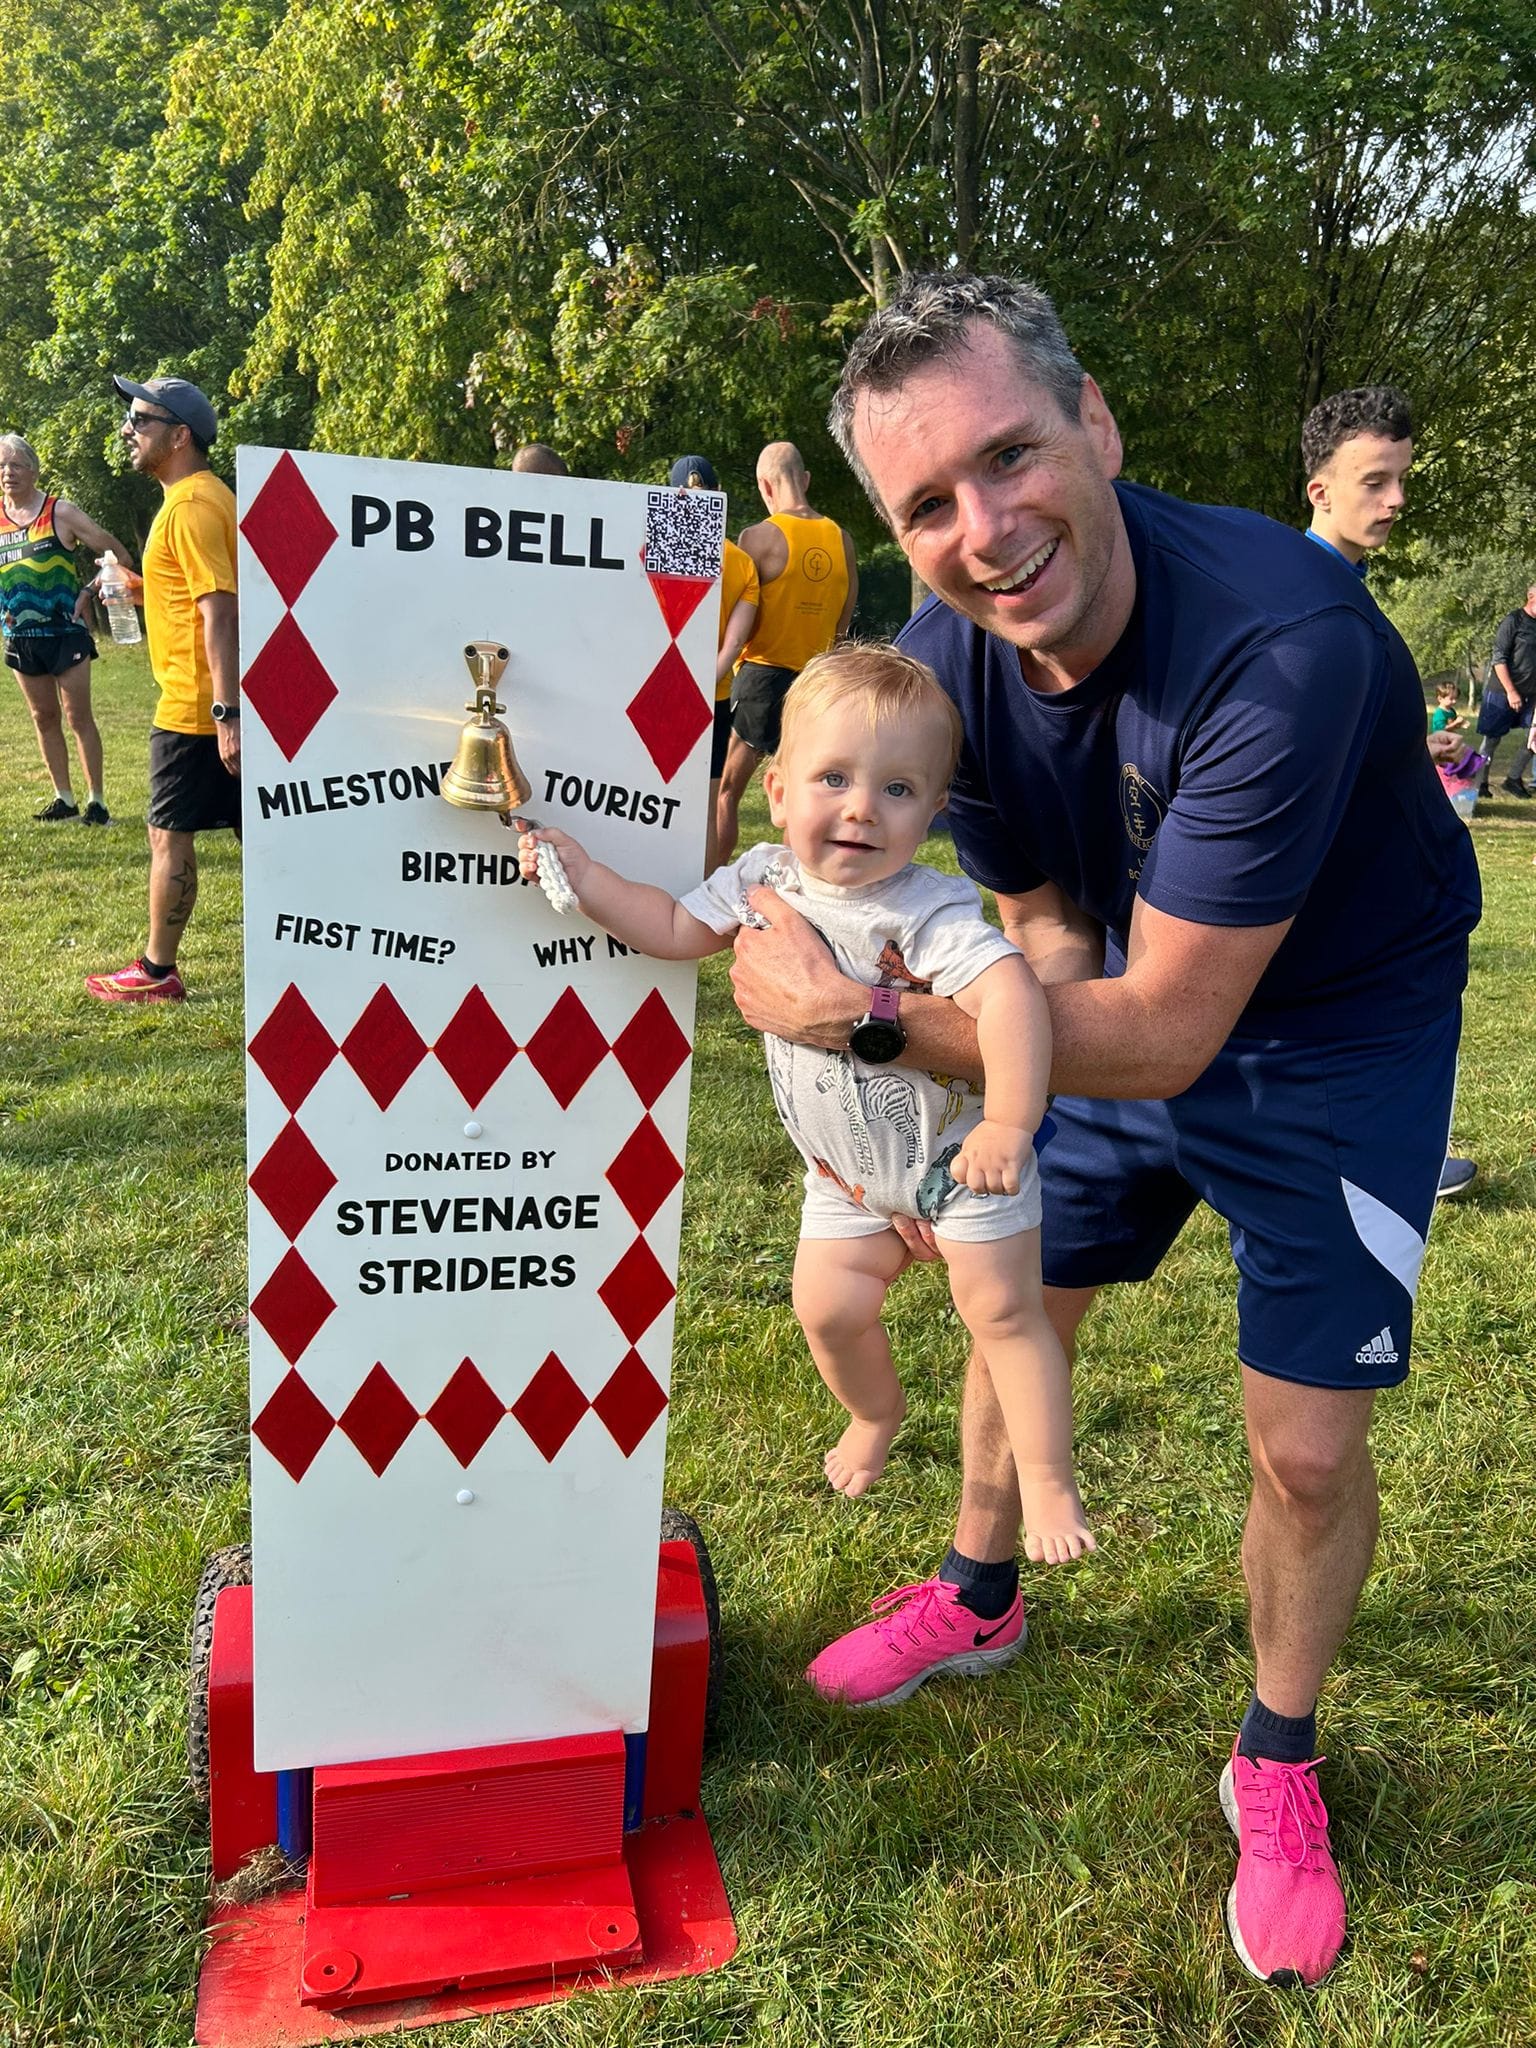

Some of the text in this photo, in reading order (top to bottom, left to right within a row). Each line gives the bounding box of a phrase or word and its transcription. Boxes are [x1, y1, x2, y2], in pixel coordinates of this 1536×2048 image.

[351, 494, 625, 571] PB BELL
[544, 769, 681, 830] TOURIST
[402, 850, 530, 887] BIRTHD
[275, 913, 456, 964] FIRST TIME?
[532, 933, 642, 968] WHY N
[385, 1150, 557, 1172] DONATED BY
[336, 1195, 601, 1236] STEVENAGE
[358, 1254, 576, 1295] STRIDERS
[1355, 1350, 1399, 1364] adidas
